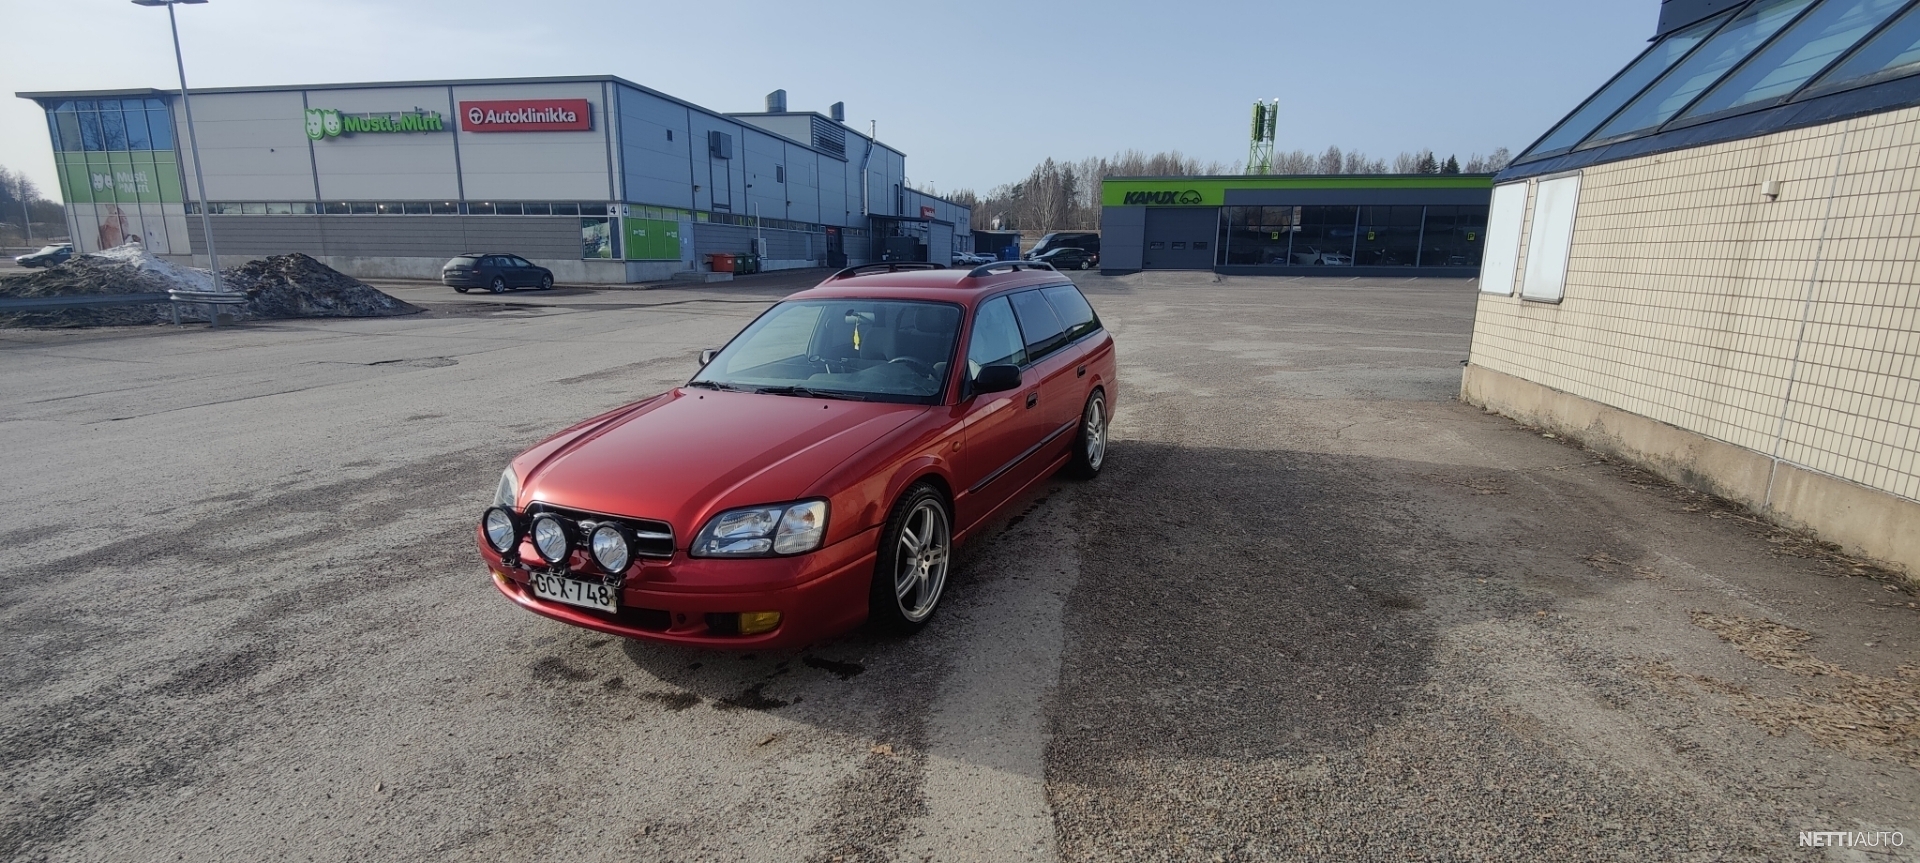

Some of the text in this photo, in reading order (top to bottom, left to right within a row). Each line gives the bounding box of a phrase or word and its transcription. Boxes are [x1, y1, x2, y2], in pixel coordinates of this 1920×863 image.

[484, 107, 577, 124] Autoklinikka
[344, 115, 393, 132] Musti
[401, 113, 443, 131] Mirri
[116, 171, 148, 182] Musti
[124, 182, 150, 193] Mrri
[1123, 191, 1179, 205] KAMUX
[610, 206, 616, 215] 4
[623, 206, 628, 214] 4
[535, 574, 610, 606] GCX-748
